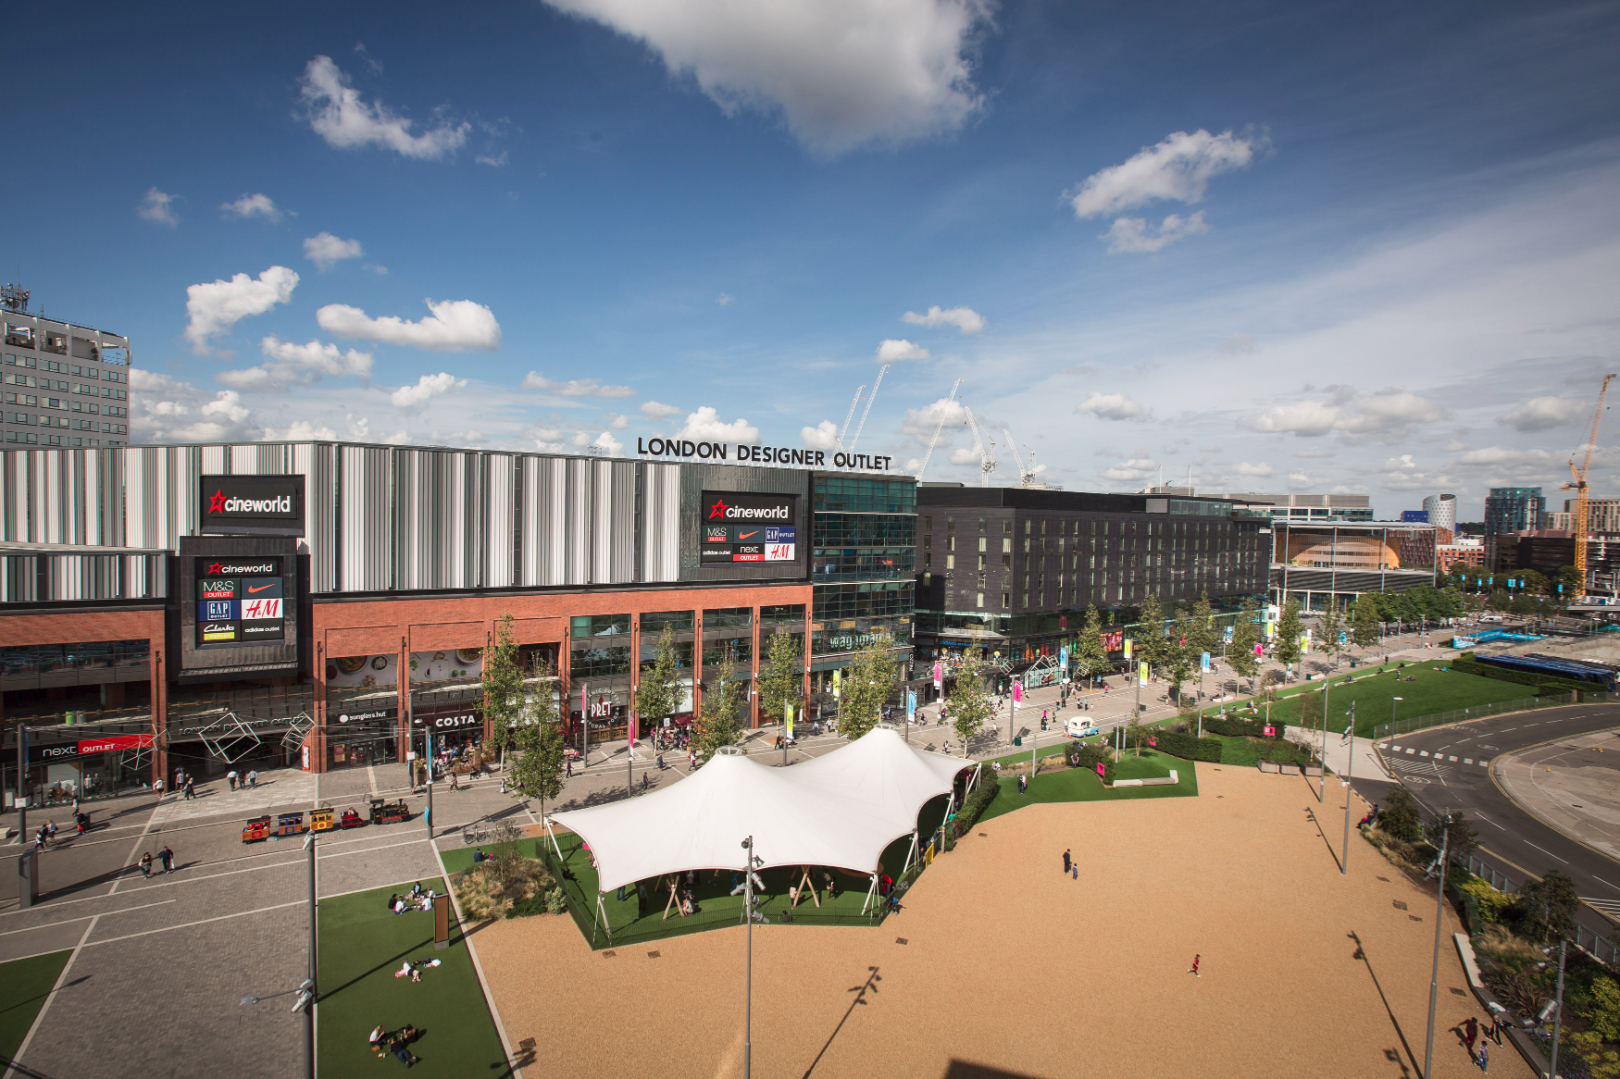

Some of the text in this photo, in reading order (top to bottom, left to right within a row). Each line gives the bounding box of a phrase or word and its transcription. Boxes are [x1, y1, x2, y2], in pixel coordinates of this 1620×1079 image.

[637, 437, 892, 470] LONDON DESIGNER OUTLET
[224, 495, 291, 513] cineworld
[725, 505, 789, 519] cineworld
[707, 527, 727, 537] M&S
[770, 544, 790, 559] H&M
[221, 564, 273, 573] cineworld
[203, 581, 234, 592] M&S
[210, 602, 228, 614] GAP
[246, 599, 279, 618] H&M
[203, 624, 235, 633] Clarks
[591, 701, 612, 718] PRET
[435, 715, 476, 728] COSTA
[42, 743, 115, 757] next OUTLET
